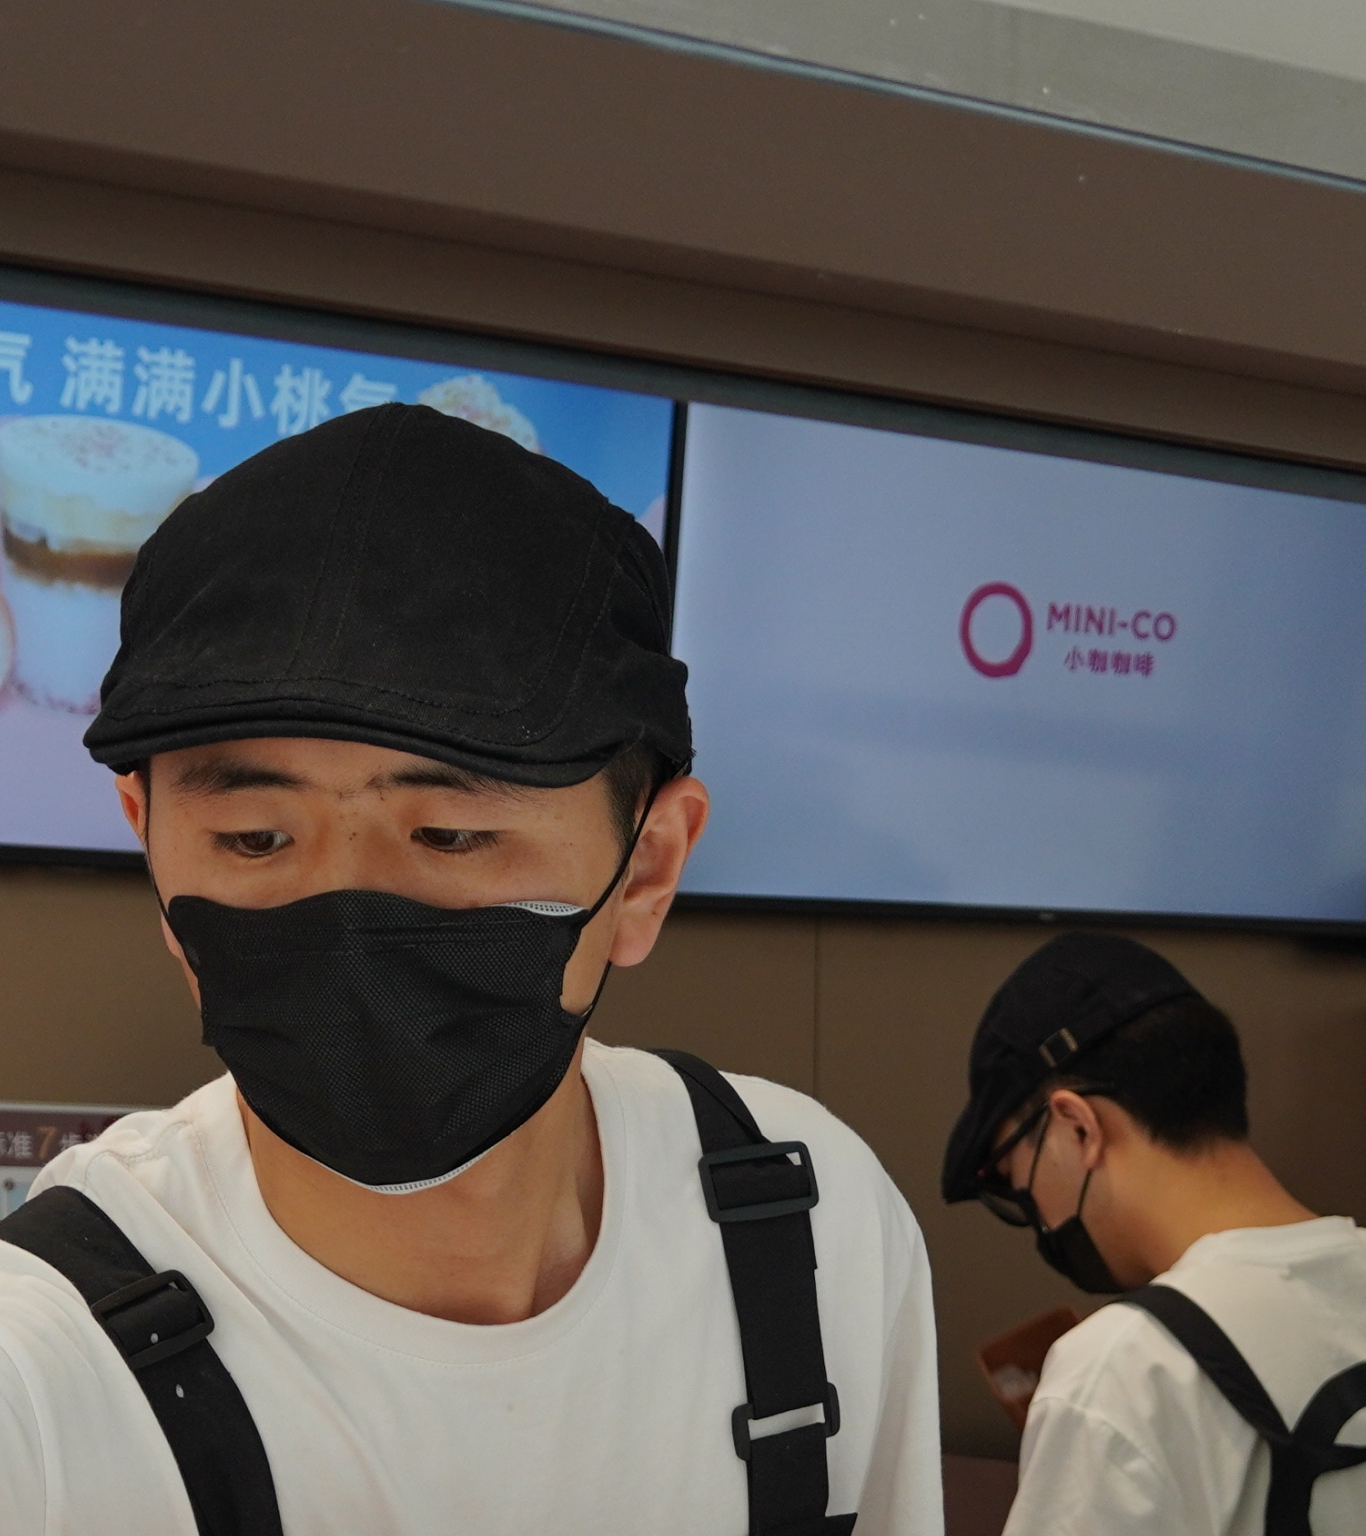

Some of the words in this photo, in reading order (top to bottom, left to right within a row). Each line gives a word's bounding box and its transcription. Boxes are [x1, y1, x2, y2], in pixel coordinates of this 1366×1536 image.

[1046, 602, 1178, 642] MINI-CO
[1064, 647, 1155, 677] 小咖咖啡
